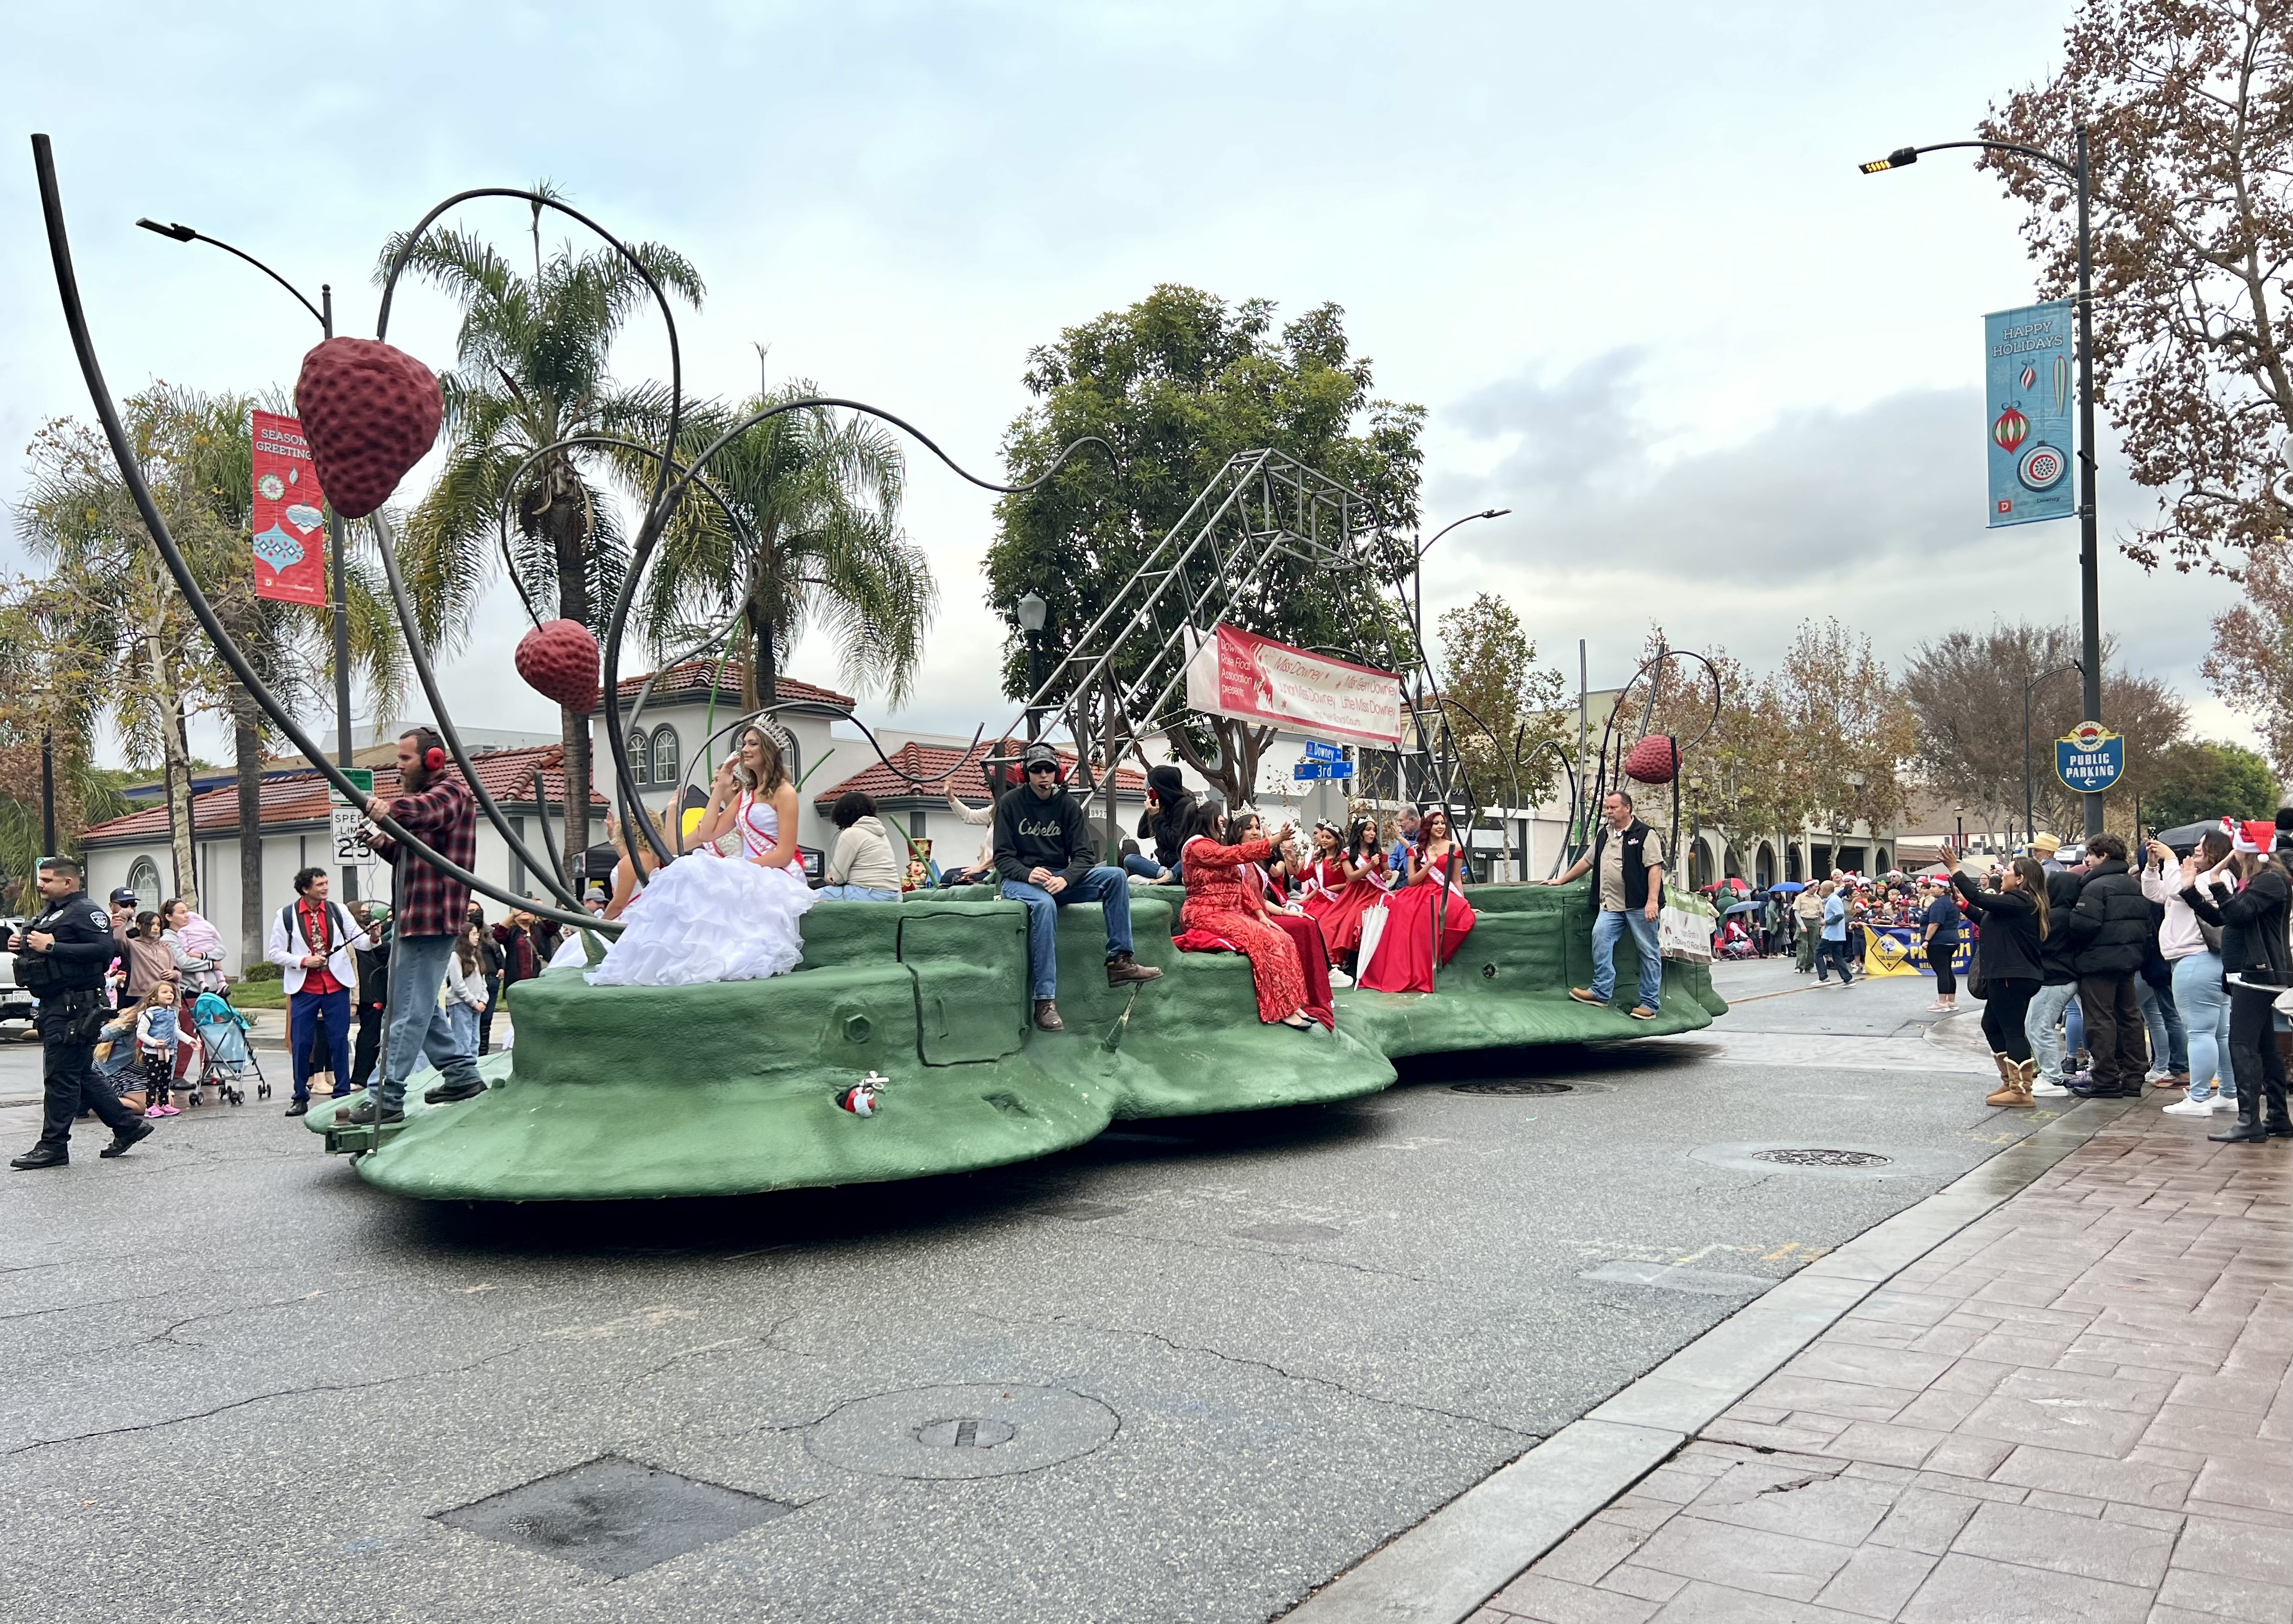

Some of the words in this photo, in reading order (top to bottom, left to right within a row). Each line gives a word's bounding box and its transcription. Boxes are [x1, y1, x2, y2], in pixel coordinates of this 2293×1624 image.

[2003, 321, 2051, 340] HAPPY
[1993, 335, 2062, 357] HOLIDAYS
[261, 428, 307, 446] SEASON
[256, 441, 312, 460] GREETING
[1221, 653, 1234, 667] Rose
[1235, 657, 1250, 671] Float
[1274, 656, 1293, 673] Miss
[1291, 661, 1324, 683] Downey
[1221, 668, 1252, 685] Association
[1222, 684, 1245, 697] presents
[1342, 675, 1357, 689] Miss
[1355, 678, 1370, 692] Teen
[1370, 680, 1397, 699] Downey
[1295, 684, 1309, 700] Miss
[1309, 688, 1335, 710] Downey
[1341, 695, 1355, 710] Little
[1355, 698, 1370, 713] Miss
[1369, 700, 1396, 719] Downey
[1314, 743, 1334, 762] Downey
[2069, 753, 2110, 766] PUBLIC
[1317, 764, 1332, 778] 3rd
[2066, 765, 2114, 778] PARKING
[341, 827, 357, 835] LIM
[1018, 818, 1061, 836] Cabela
